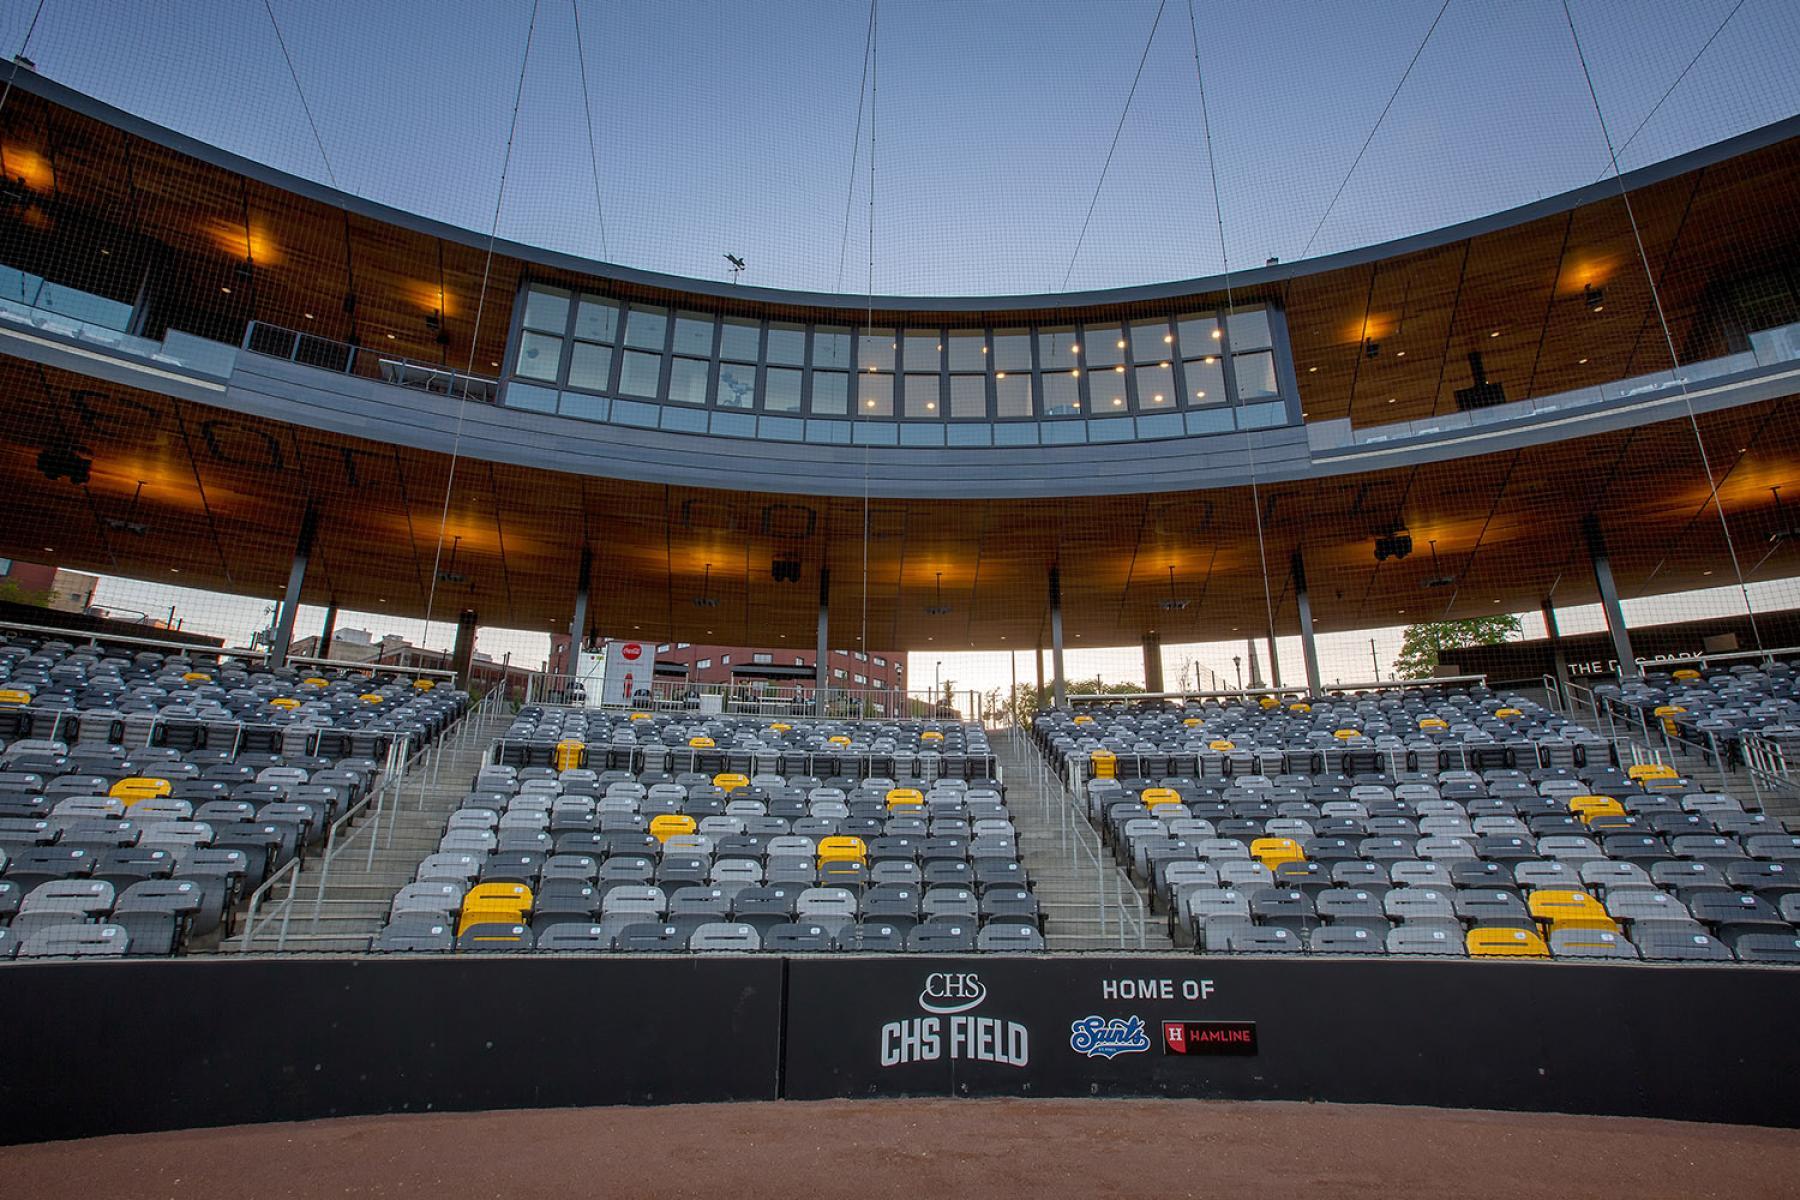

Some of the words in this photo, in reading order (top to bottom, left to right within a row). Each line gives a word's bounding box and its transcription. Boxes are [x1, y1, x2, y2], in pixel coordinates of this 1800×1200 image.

[1567, 660, 1602, 675] THE
[925, 972, 980, 998] CHS
[1103, 979, 1173, 999] HOME
[1182, 979, 1215, 999] OF
[881, 1017, 941, 1067] CHS
[950, 1016, 1029, 1067] FIELD
[1070, 1015, 1151, 1056] Saints
[1168, 1027, 1183, 1041] H
[1190, 1030, 1251, 1042] HAMLINE
